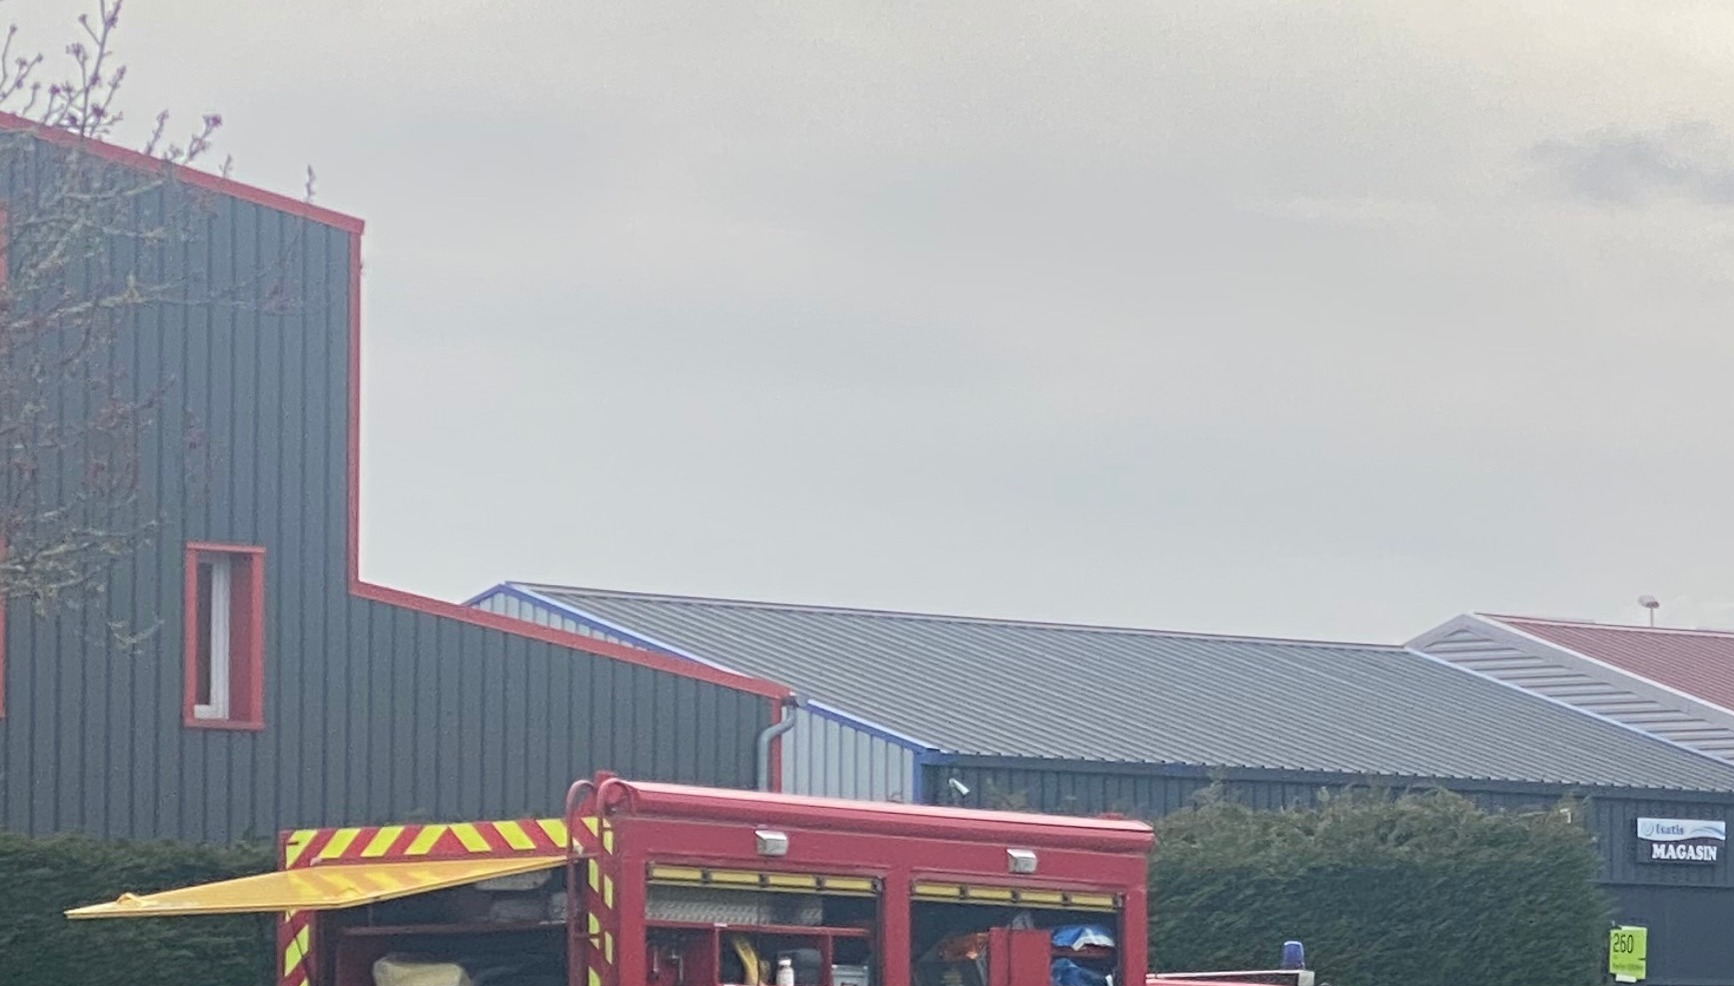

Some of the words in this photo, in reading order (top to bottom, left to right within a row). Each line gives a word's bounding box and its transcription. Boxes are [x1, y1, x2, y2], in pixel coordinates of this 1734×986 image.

[1655, 822, 1684, 836] Isatis
[1652, 843, 1717, 862] MAGASIN
[1613, 933, 1634, 953] 260
